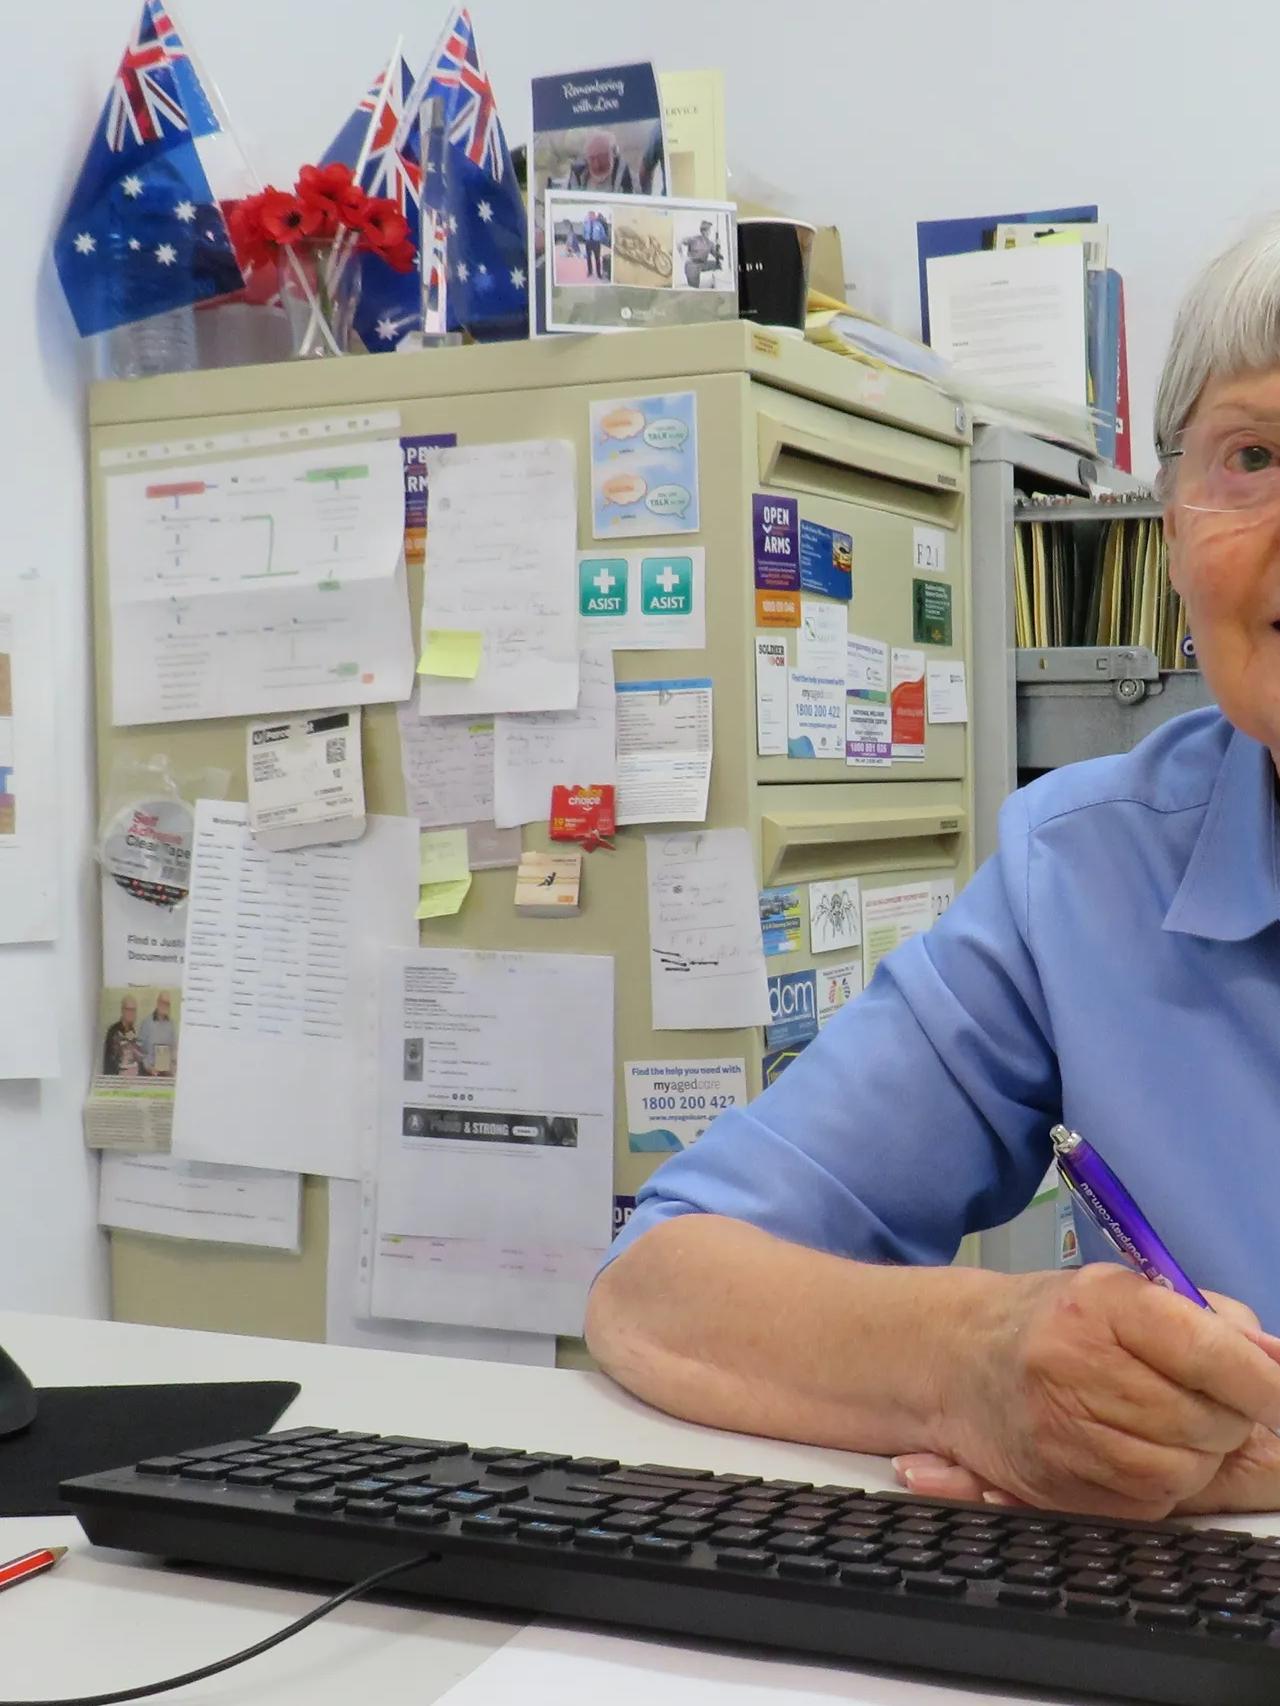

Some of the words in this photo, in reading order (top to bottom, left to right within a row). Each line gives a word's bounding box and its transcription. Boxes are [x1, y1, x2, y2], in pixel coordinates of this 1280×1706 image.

[562, 79, 625, 99] Remembering
[572, 100, 592, 114] with
[763, 506, 789, 525] OPEN
[764, 536, 791, 554] ARMS
[588, 598, 622, 611] ASIST
[651, 597, 685, 609] ASIST
[758, 644, 785, 655] SOLDIER
[796, 704, 812, 717] 1800
[814, 705, 827, 717] 200
[828, 706, 840, 718] 422
[126, 834, 162, 851] Clear
[164, 843, 191, 861] Tape
[128, 935, 149, 946] Find
[128, 951, 177, 963] Document
[769, 978, 815, 1018] dcm
[632, 1067, 649, 1076] Find
[651, 1067, 664, 1075] the
[665, 1066, 682, 1076] help
[684, 1068, 699, 1076] you
[701, 1066, 720, 1075] need
[721, 1064, 741, 1073] with
[642, 1096, 675, 1110] 1800
[680, 1096, 706, 1109] 200
[709, 1095, 736, 1109] 422
[472, 1122, 509, 1136] STRONG
[1080, 1181, 1148, 1266] yourplay.com.au
